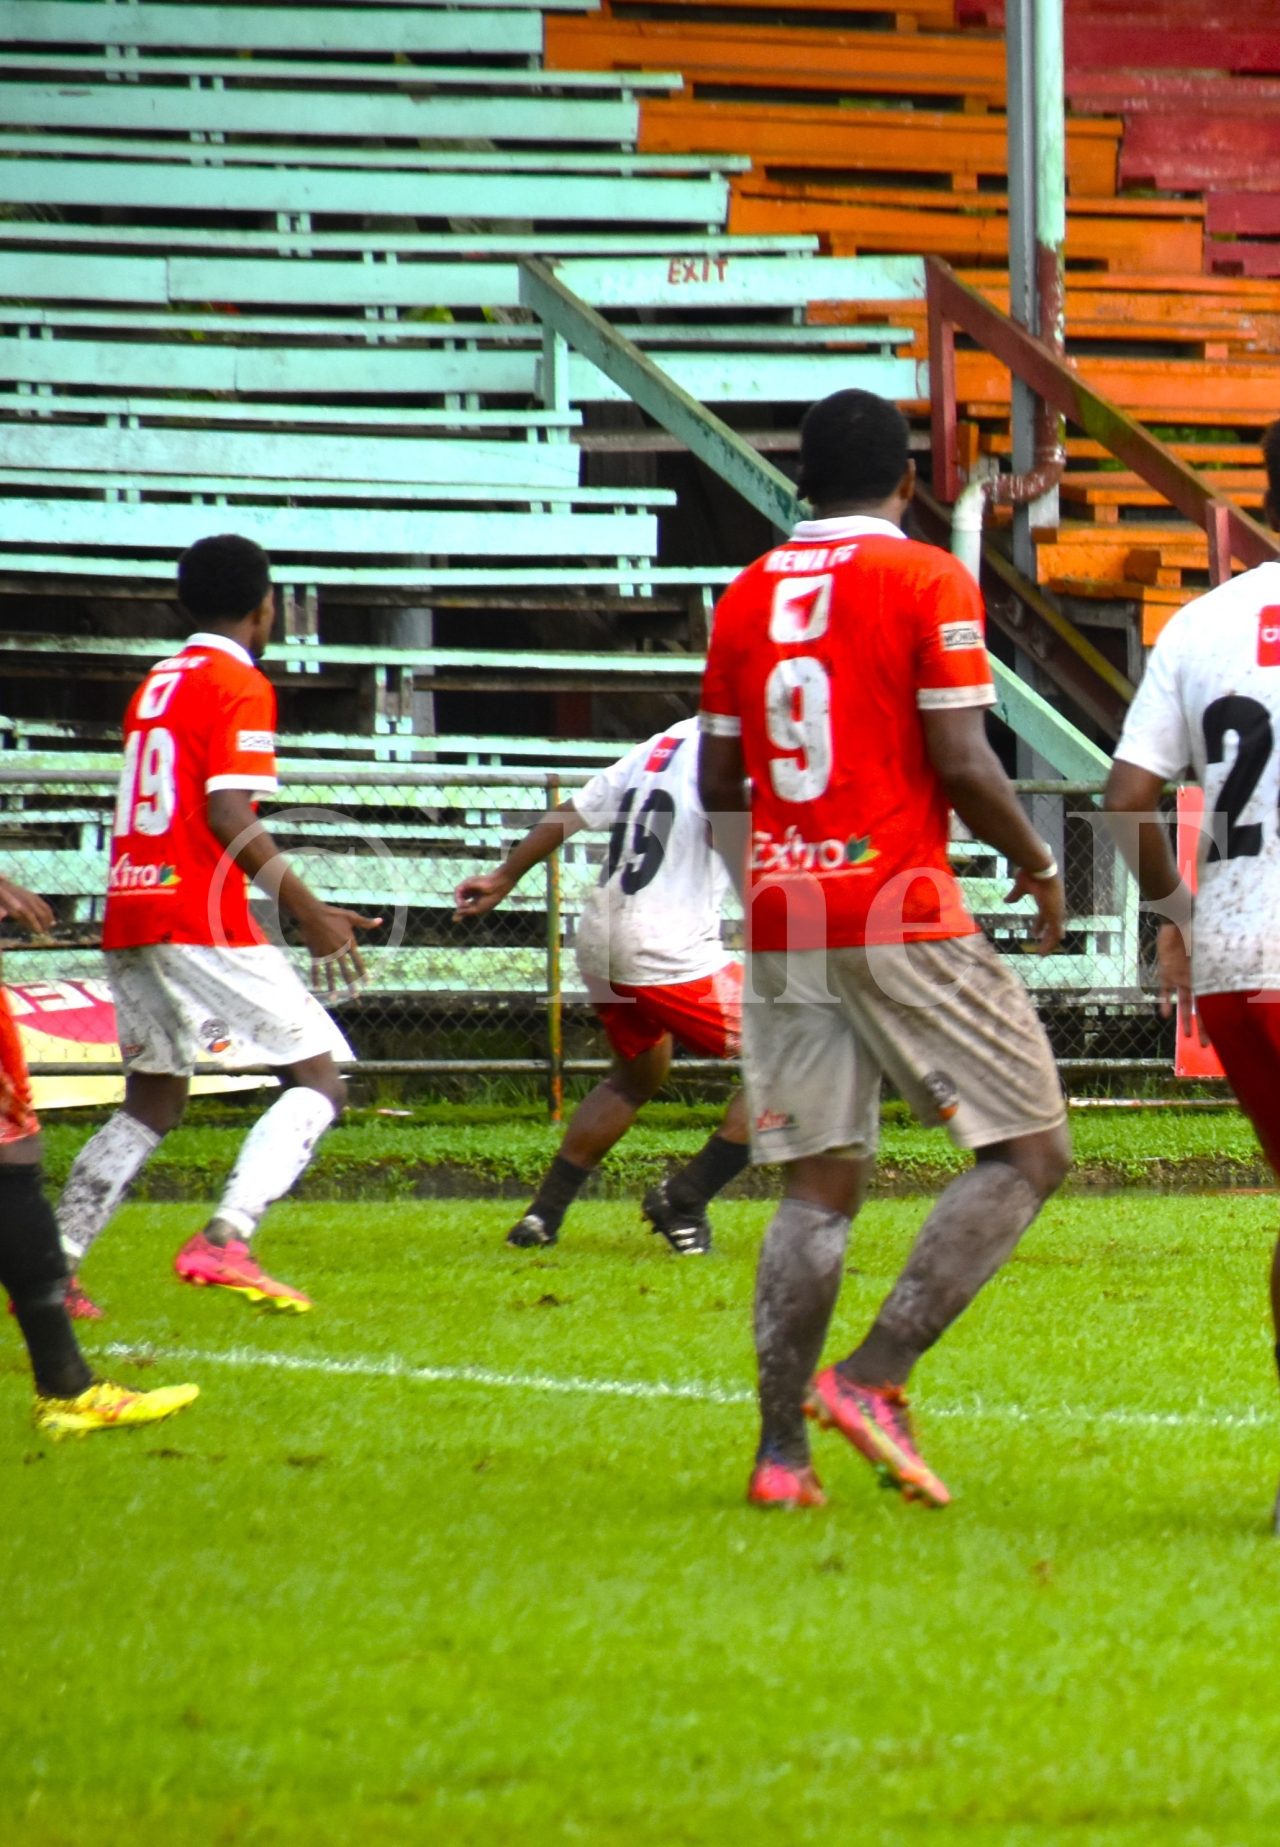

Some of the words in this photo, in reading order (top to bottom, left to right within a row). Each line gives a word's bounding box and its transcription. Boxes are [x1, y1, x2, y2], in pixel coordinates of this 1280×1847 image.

[667, 257, 729, 285] EXIT
[114, 727, 176, 837] 19
[765, 656, 832, 803] 9
